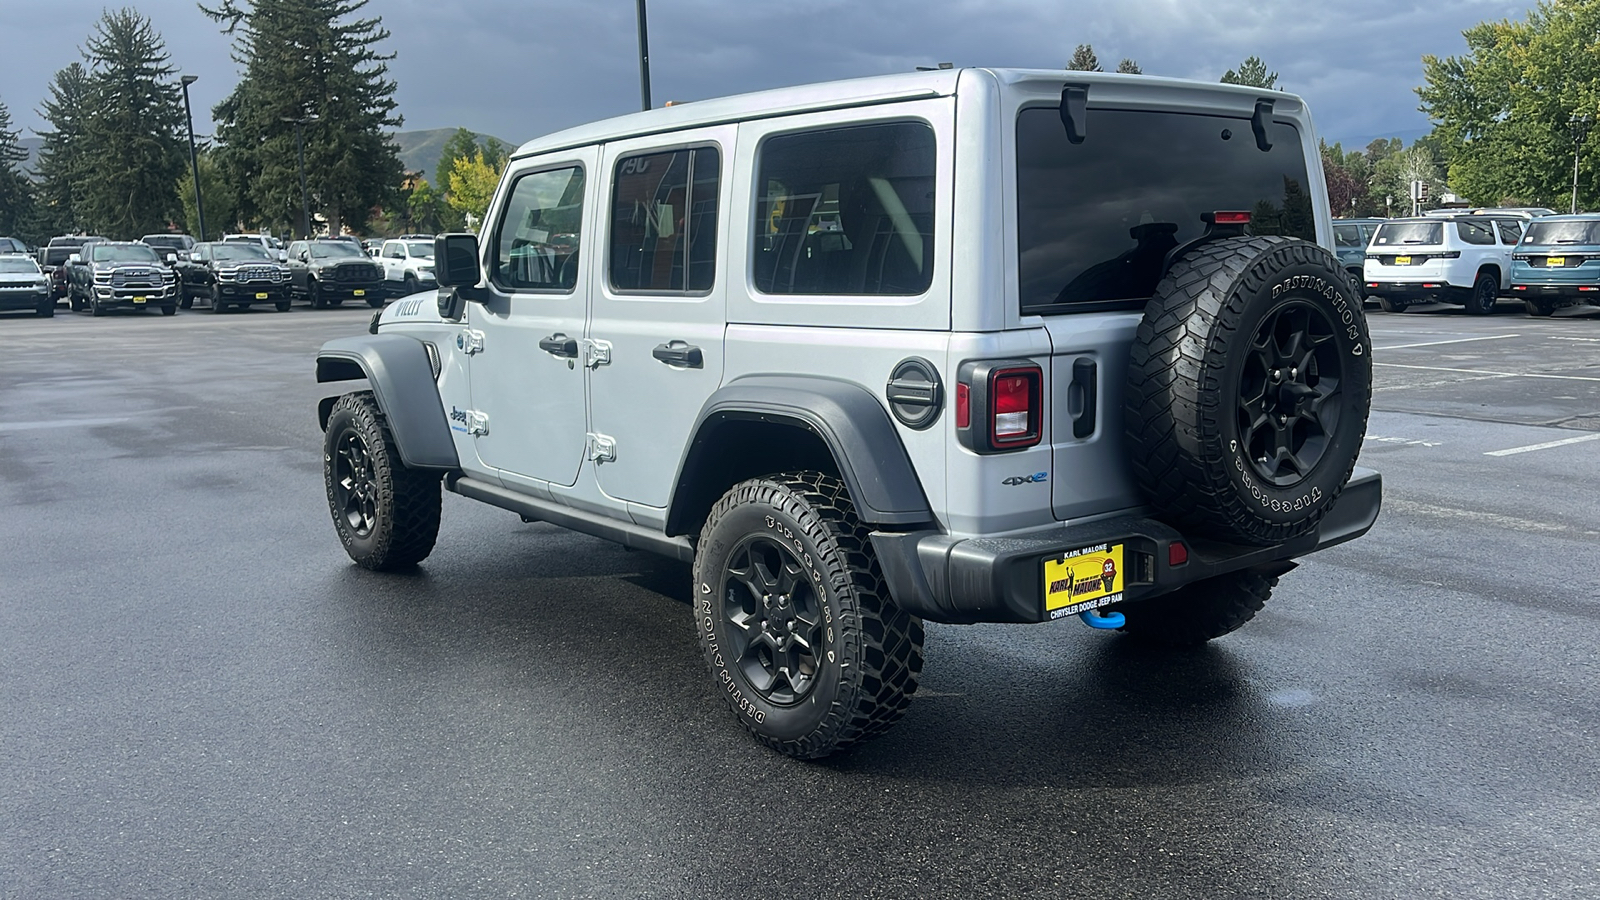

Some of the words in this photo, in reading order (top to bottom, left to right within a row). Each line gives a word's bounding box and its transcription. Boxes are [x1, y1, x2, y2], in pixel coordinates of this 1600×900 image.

[395, 299, 424, 316] WILLYS
[1272, 275, 1359, 340] DESTINATION
[1235, 456, 1322, 513] Firestone
[1063, 550, 1081, 559] KARL
[1082, 543, 1107, 555] MALONE
[1104, 563, 1113, 572] 32
[1049, 578, 1070, 595] KARL
[1073, 578, 1102, 597] MALONE
[1050, 605, 1078, 619] CHRYSLER
[1079, 599, 1098, 612] DODGE
[1098, 597, 1111, 607] JEEP
[1111, 593, 1123, 603] RAM
[702, 600, 766, 724] DESTINATION
